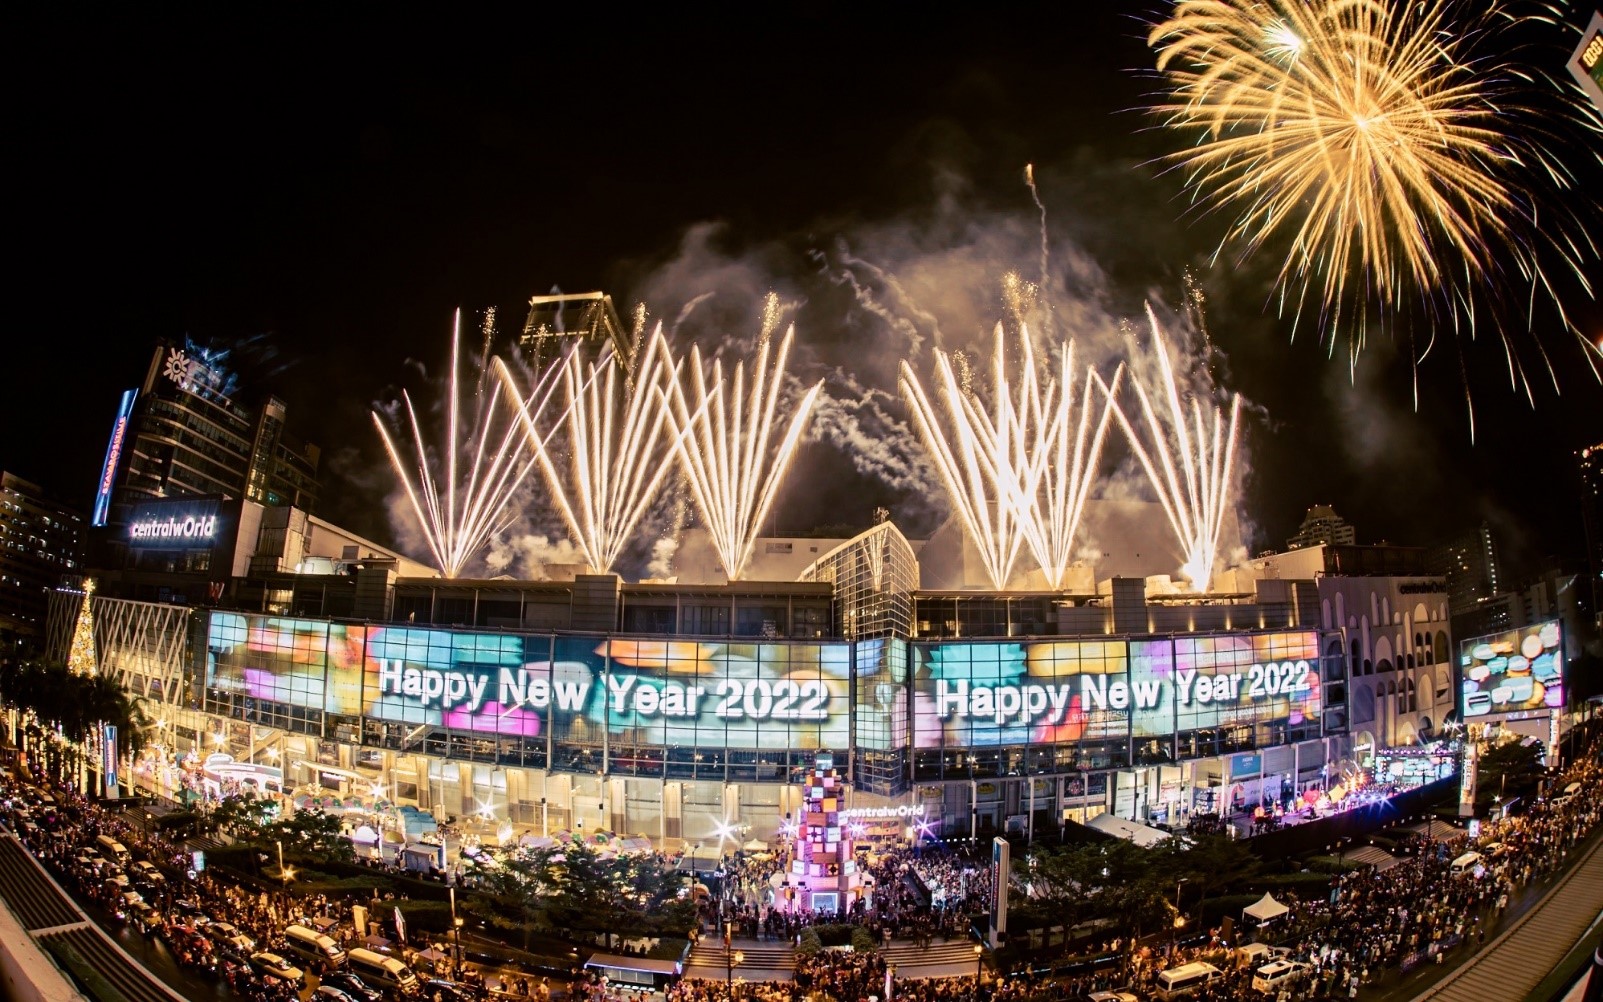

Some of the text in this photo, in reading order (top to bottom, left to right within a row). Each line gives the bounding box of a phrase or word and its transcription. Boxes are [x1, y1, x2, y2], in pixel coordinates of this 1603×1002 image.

[379, 658, 828, 719] Happy New Year 2022
[936, 660, 1311, 724] Happy New Year 2022
